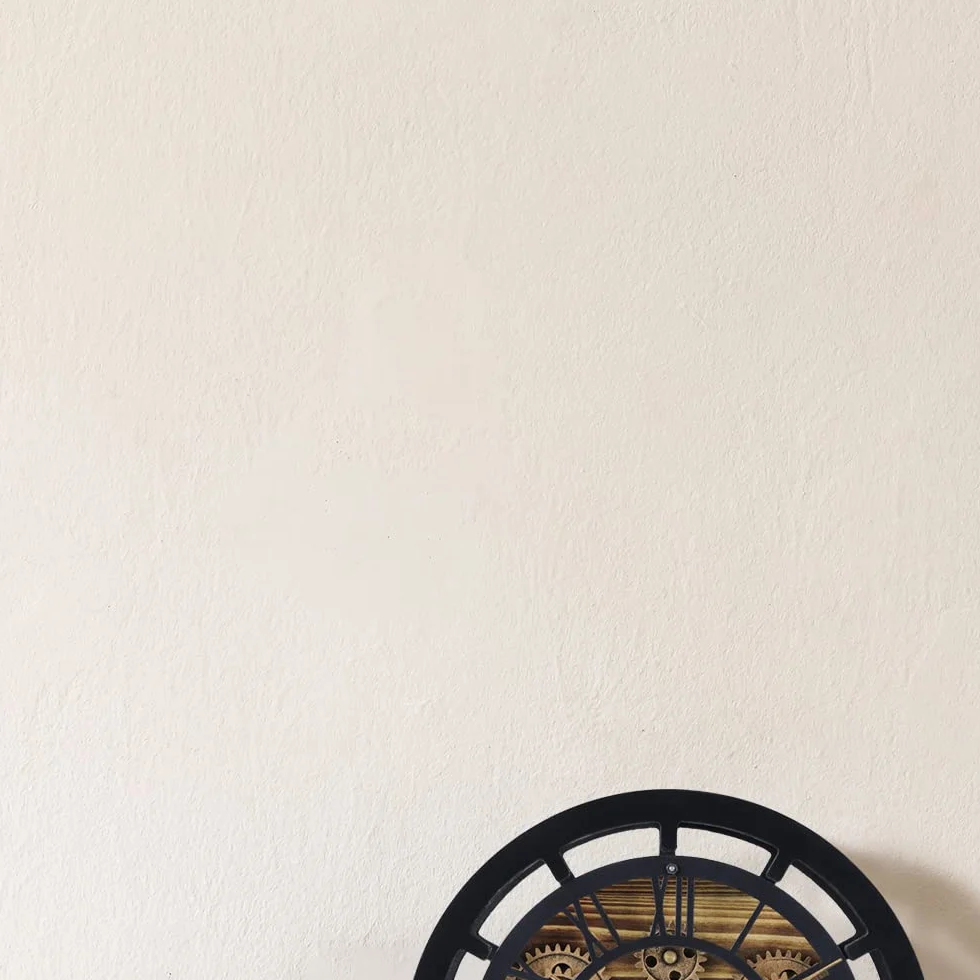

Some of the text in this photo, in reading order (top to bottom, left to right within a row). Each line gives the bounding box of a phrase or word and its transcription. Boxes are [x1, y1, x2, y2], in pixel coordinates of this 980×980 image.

[562, 892, 620, 958] XI
[650, 876, 694, 937] XII
[731, 902, 767, 951] I
